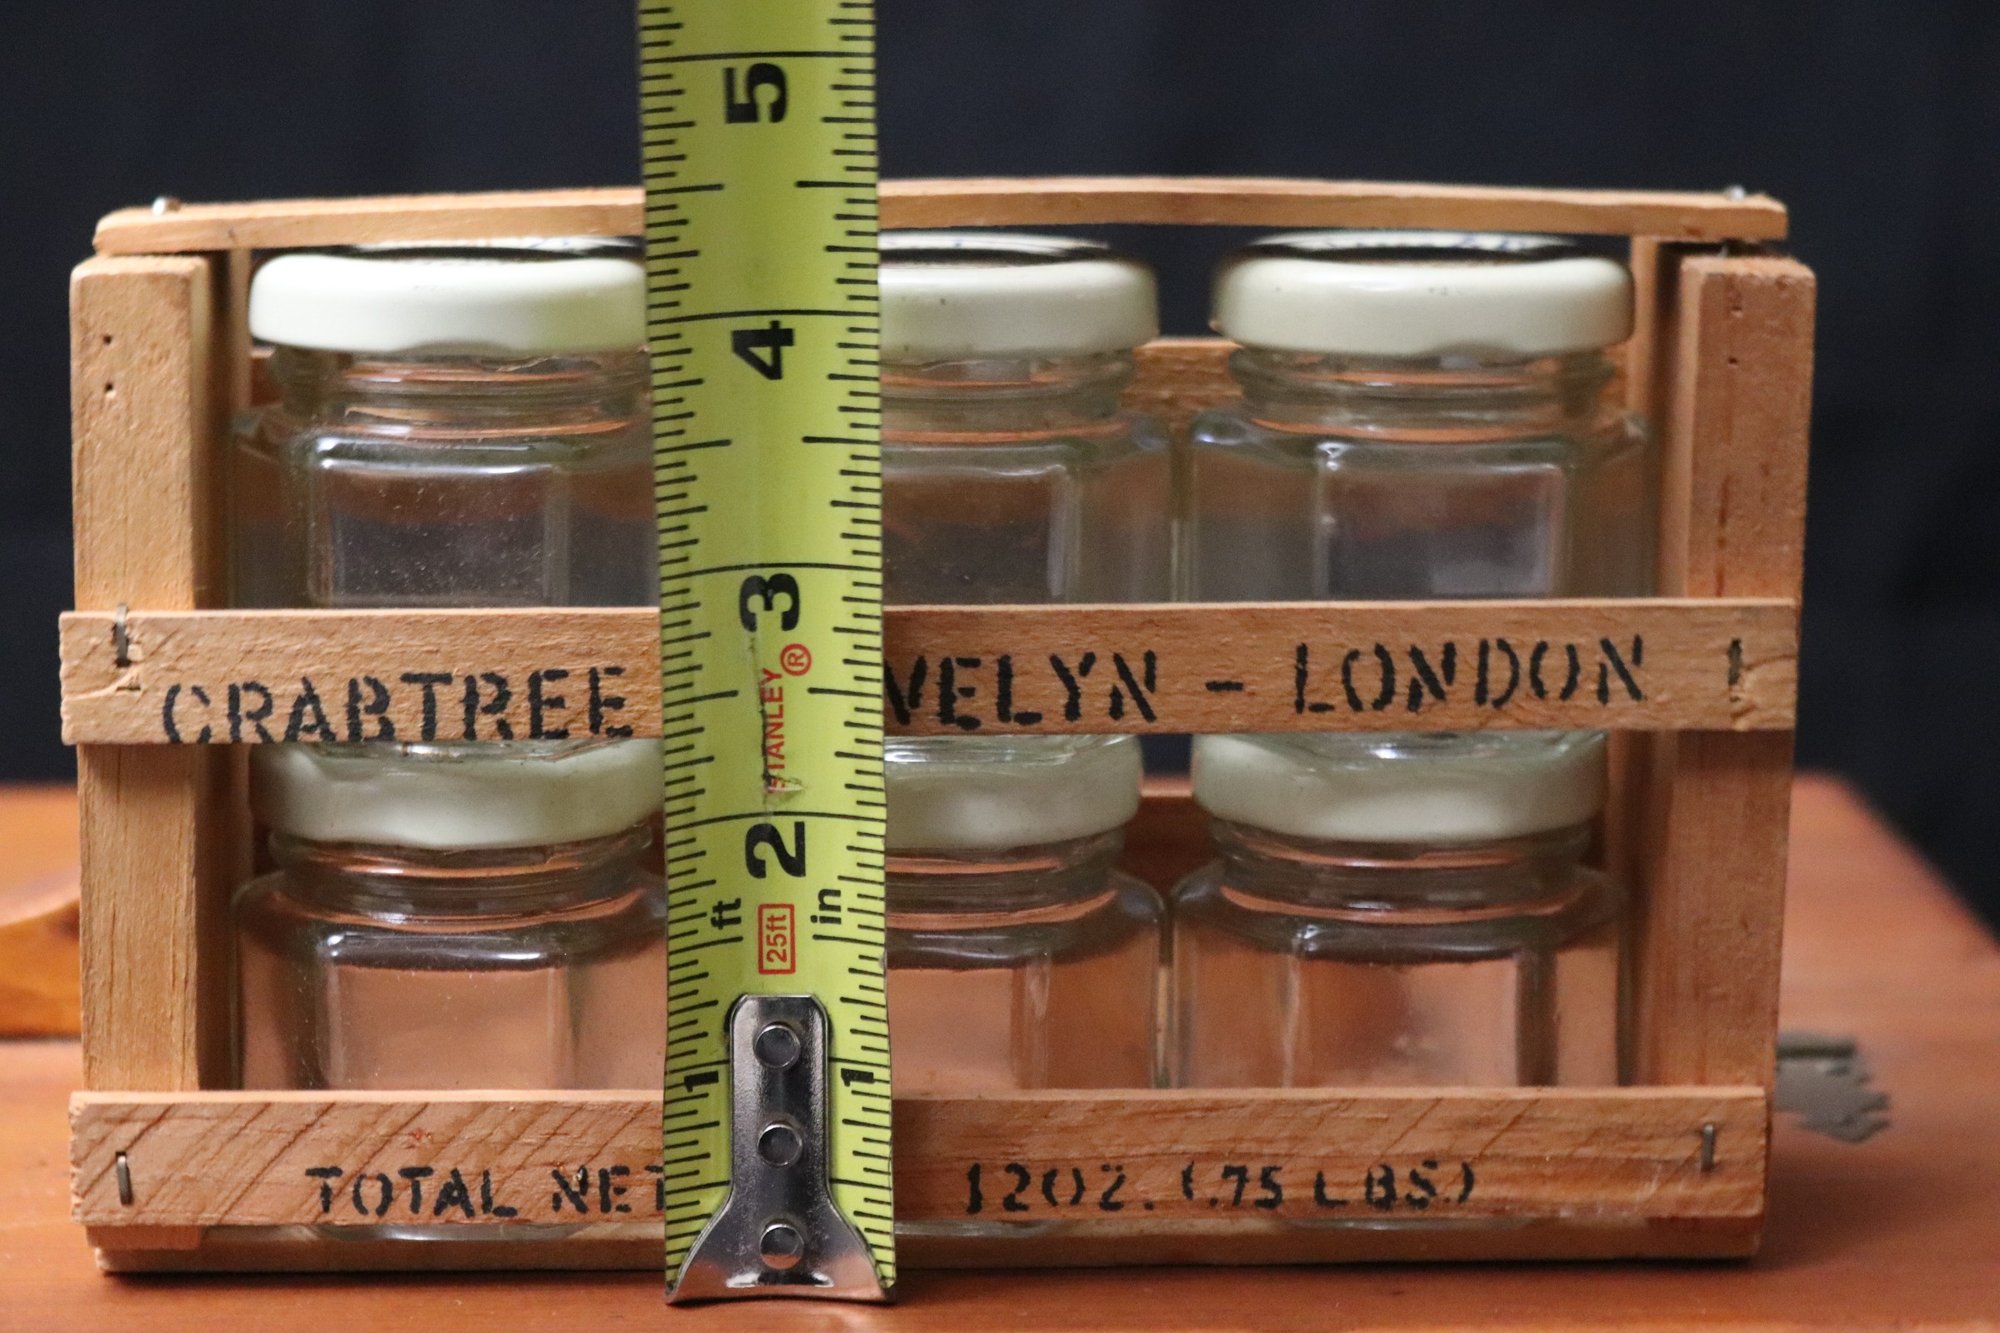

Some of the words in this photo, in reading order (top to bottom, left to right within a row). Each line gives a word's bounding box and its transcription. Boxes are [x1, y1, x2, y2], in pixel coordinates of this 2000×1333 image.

[723, 62, 788, 125] 5
[731, 320, 795, 380] 4
[739, 573, 800, 632] 3
[162, 666, 635, 744] CRABTREE
[883, 649, 1157, 731] VELYN
[1295, 633, 1646, 716] LONDON
[745, 821, 806, 879] 2
[711, 898, 742, 930] ft
[810, 888, 842, 925] in
[766, 914, 787, 963] 25ft
[684, 1071, 719, 1092] 1
[841, 1068, 875, 1087] 1
[305, 1165, 518, 1218] TOTAL
[551, 1164, 664, 1214] NET
